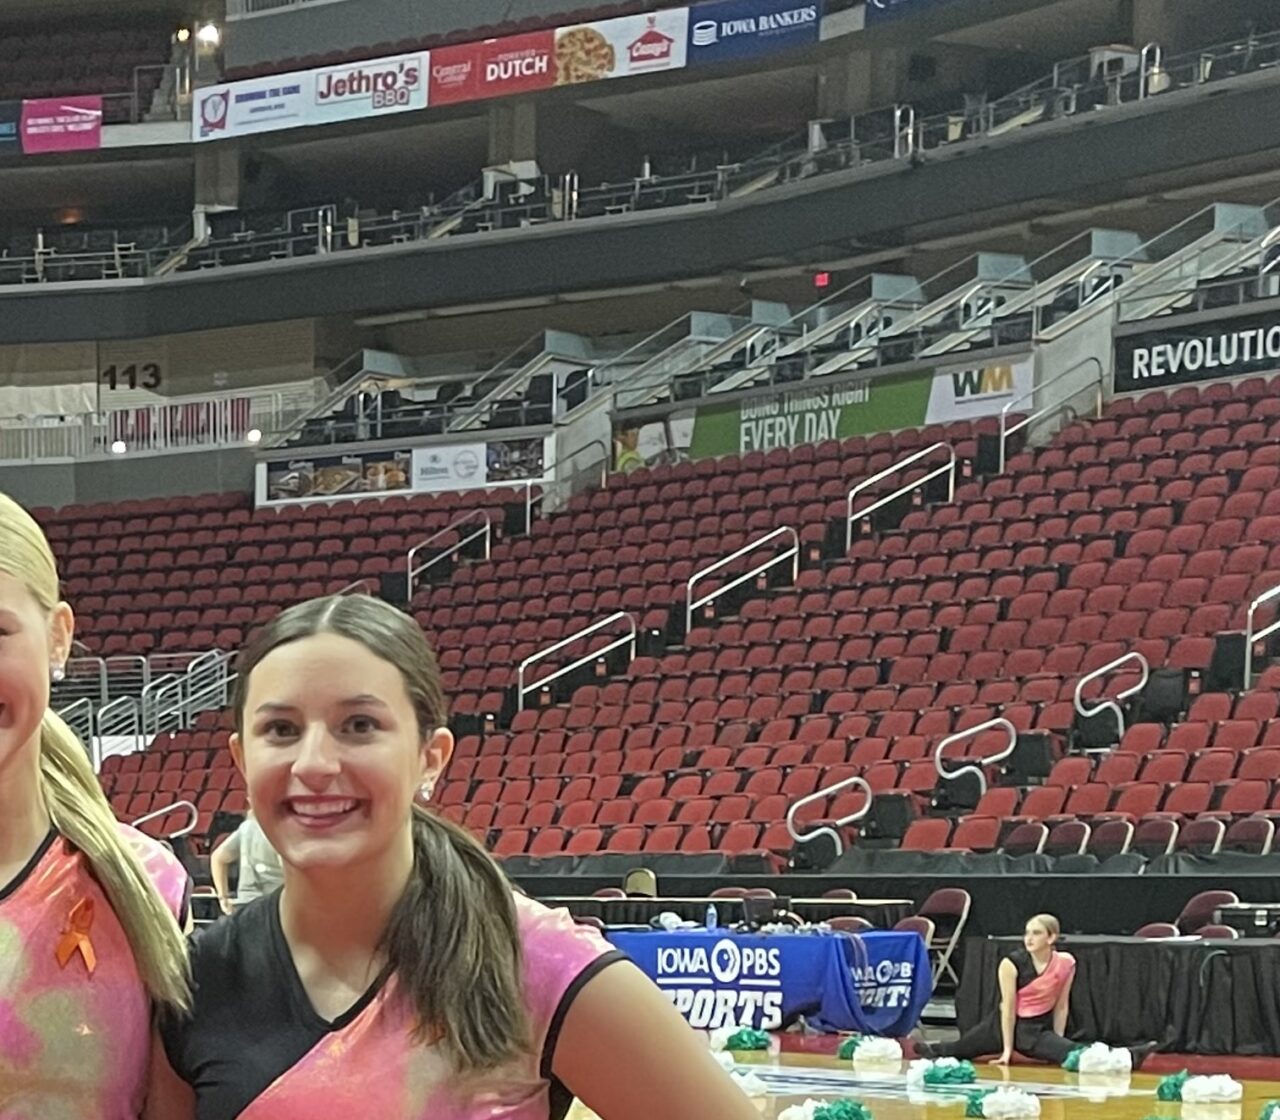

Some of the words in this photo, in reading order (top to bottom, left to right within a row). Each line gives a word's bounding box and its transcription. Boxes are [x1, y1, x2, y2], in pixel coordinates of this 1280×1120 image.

[721, 19, 757, 37] IOWA
[758, 6, 817, 31] BANKERS
[317, 63, 419, 99] Jethro's
[486, 55, 549, 81] DUTCH
[372, 86, 410, 109] BBQ
[1132, 325, 1280, 380] REVOLUTIO
[102, 363, 162, 390] 113
[952, 362, 1014, 398] WM
[740, 414, 800, 453] EVERY
[804, 408, 842, 443] DAY
[656, 947, 710, 975] IOWA
[741, 947, 781, 976] PBS
